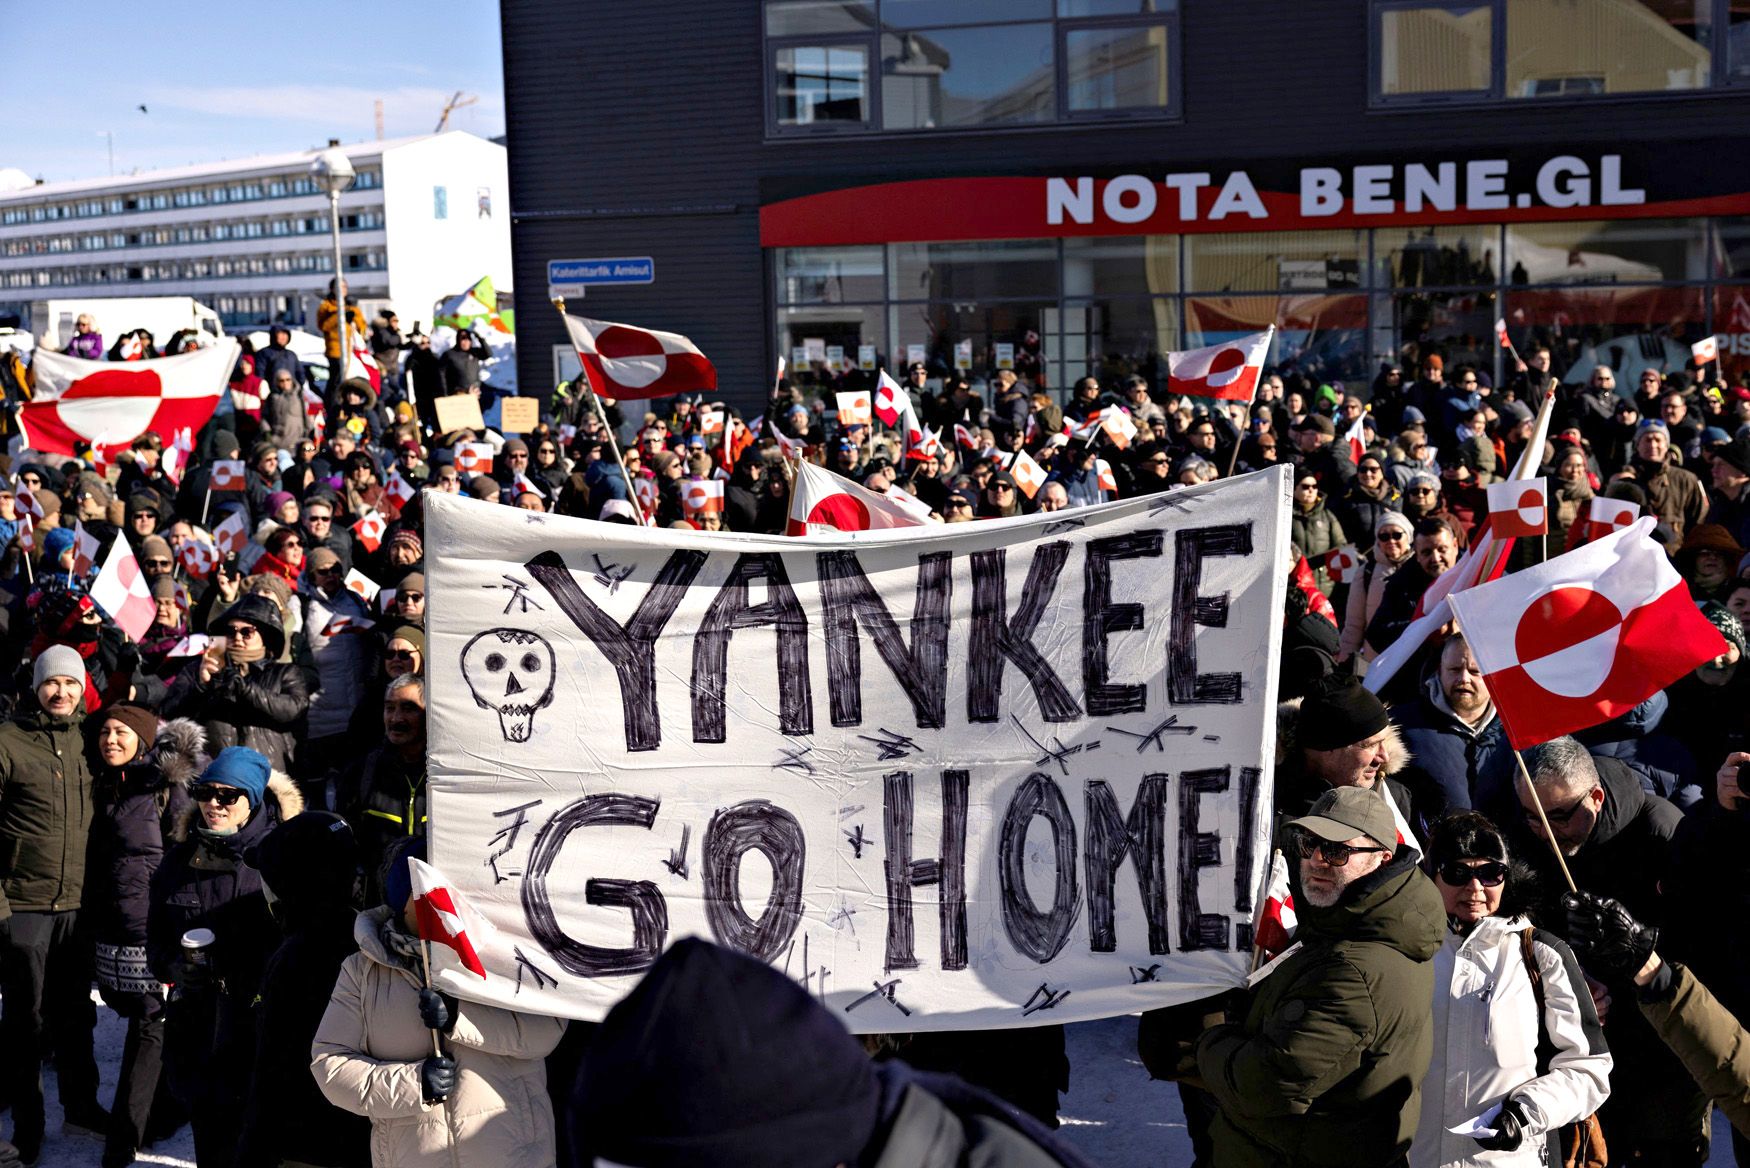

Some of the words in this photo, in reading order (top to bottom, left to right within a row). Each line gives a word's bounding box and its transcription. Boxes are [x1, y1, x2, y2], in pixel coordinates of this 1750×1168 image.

[1046, 171, 1268, 225] NOTA
[1300, 155, 1647, 217] BENE.GL
[525, 522, 1254, 752] YANKEE
[520, 794, 807, 979] GO
[883, 765, 1260, 974] HOME!
